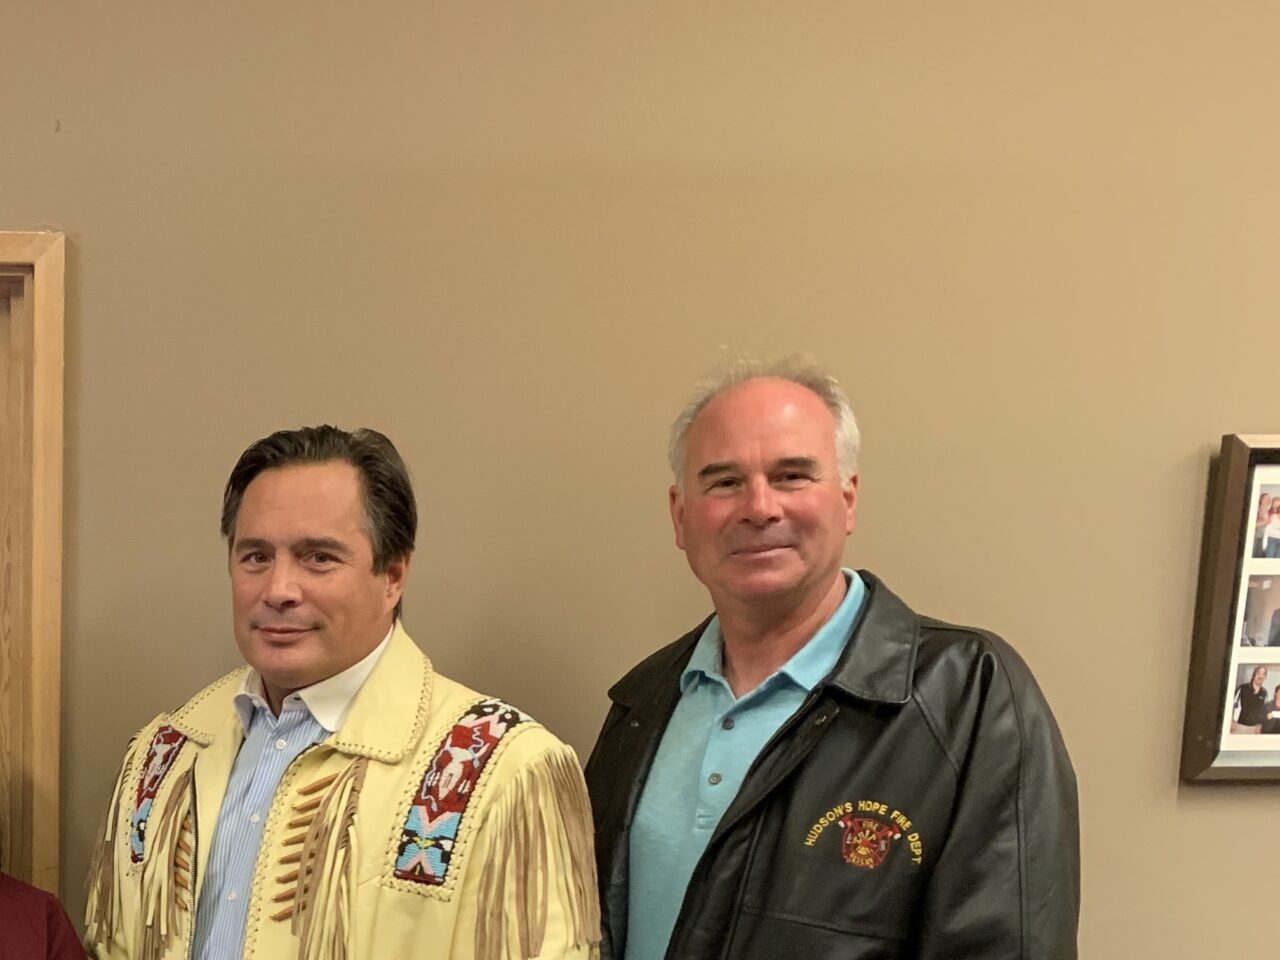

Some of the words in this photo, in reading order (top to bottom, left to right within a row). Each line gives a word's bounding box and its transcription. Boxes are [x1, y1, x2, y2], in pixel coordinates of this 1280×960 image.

[804, 801, 853, 847] HUDSON'S
[858, 800, 889, 815] HOPE
[890, 809, 913, 831] FIRE
